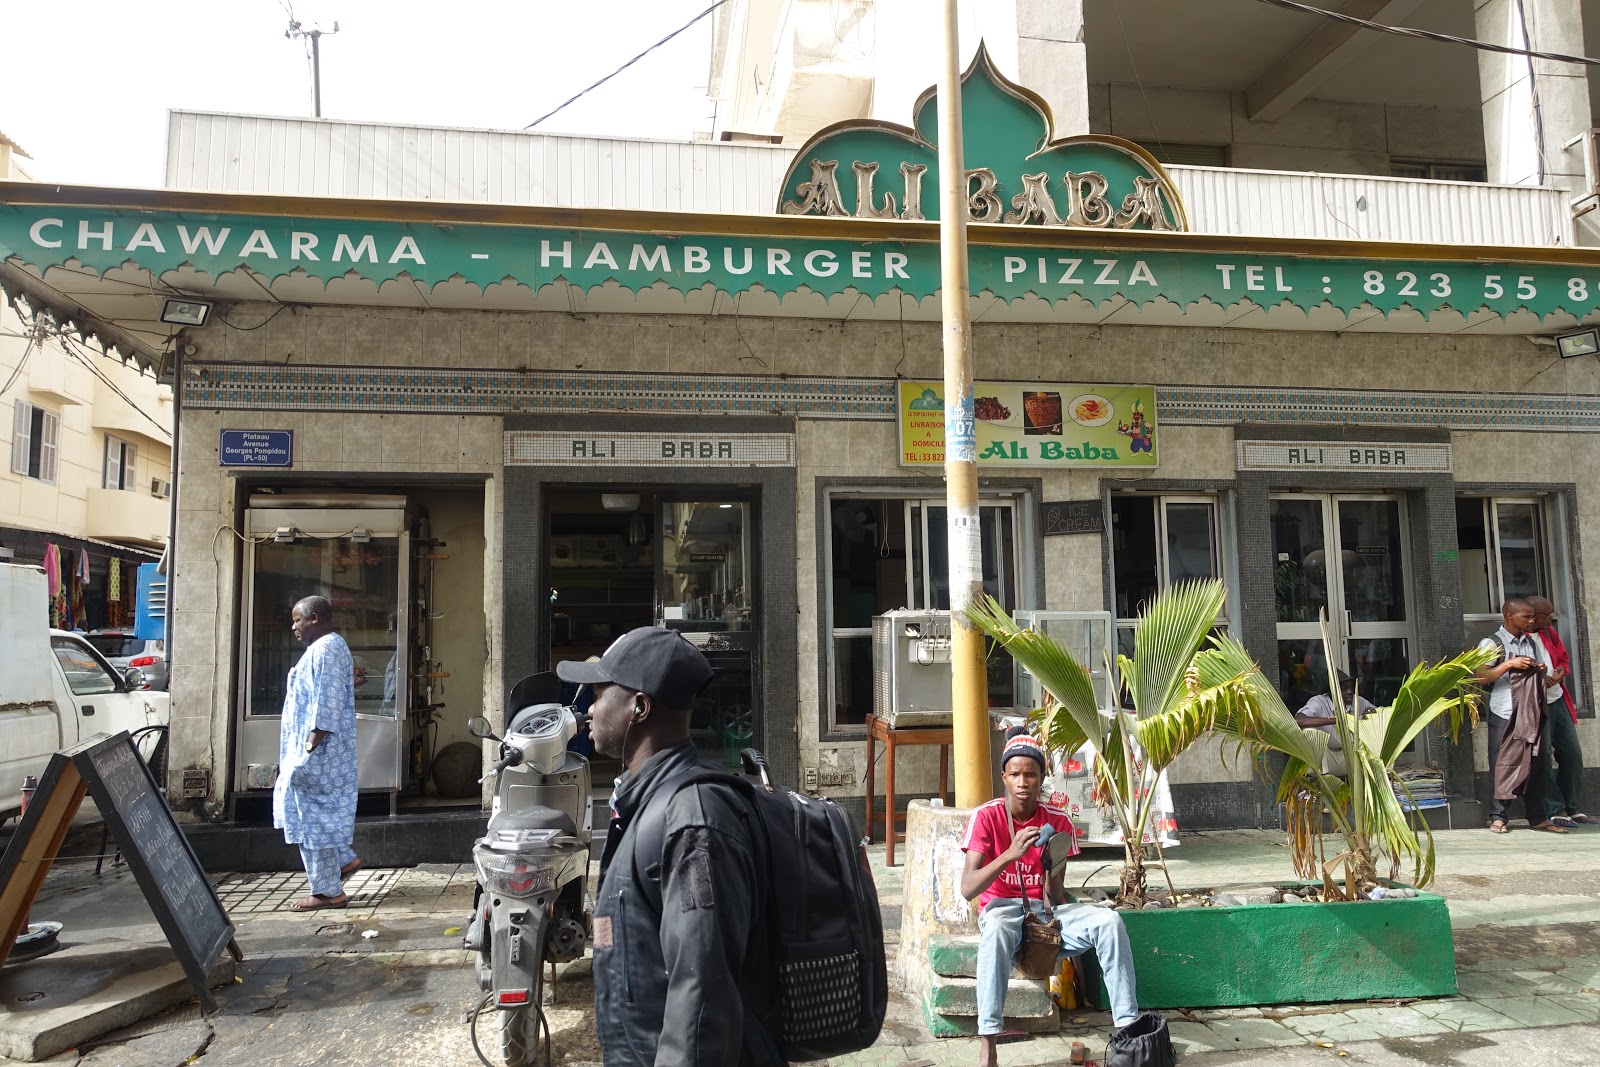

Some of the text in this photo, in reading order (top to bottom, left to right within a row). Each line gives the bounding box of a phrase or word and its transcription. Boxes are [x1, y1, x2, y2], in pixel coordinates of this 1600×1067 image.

[783, 158, 1175, 231] ALI BABA
[29, 218, 426, 265] CHAWARMA
[540, 240, 911, 279] HAMBURGER
[1004, 256, 1158, 287] PIZZA
[1216, 264, 1293, 292] TEL
[1363, 270, 1452, 298] 823
[1484, 275, 1537, 300] 55
[1567, 277, 1600, 302] 8
[225, 447, 286, 455] Georges Pompidou
[572, 439, 733, 459] ALI BABA
[905, 453, 918, 461] TEL
[922, 453, 931, 461] 33
[932, 453, 945, 461] 823
[979, 440, 1119, 461] Ali Baba
[1288, 448, 1406, 466] ALI BABA
[1059, 504, 1101, 531] ICE CREAM
[1015, 860, 1032, 874] Fly
[999, 870, 1045, 886] Emirate
